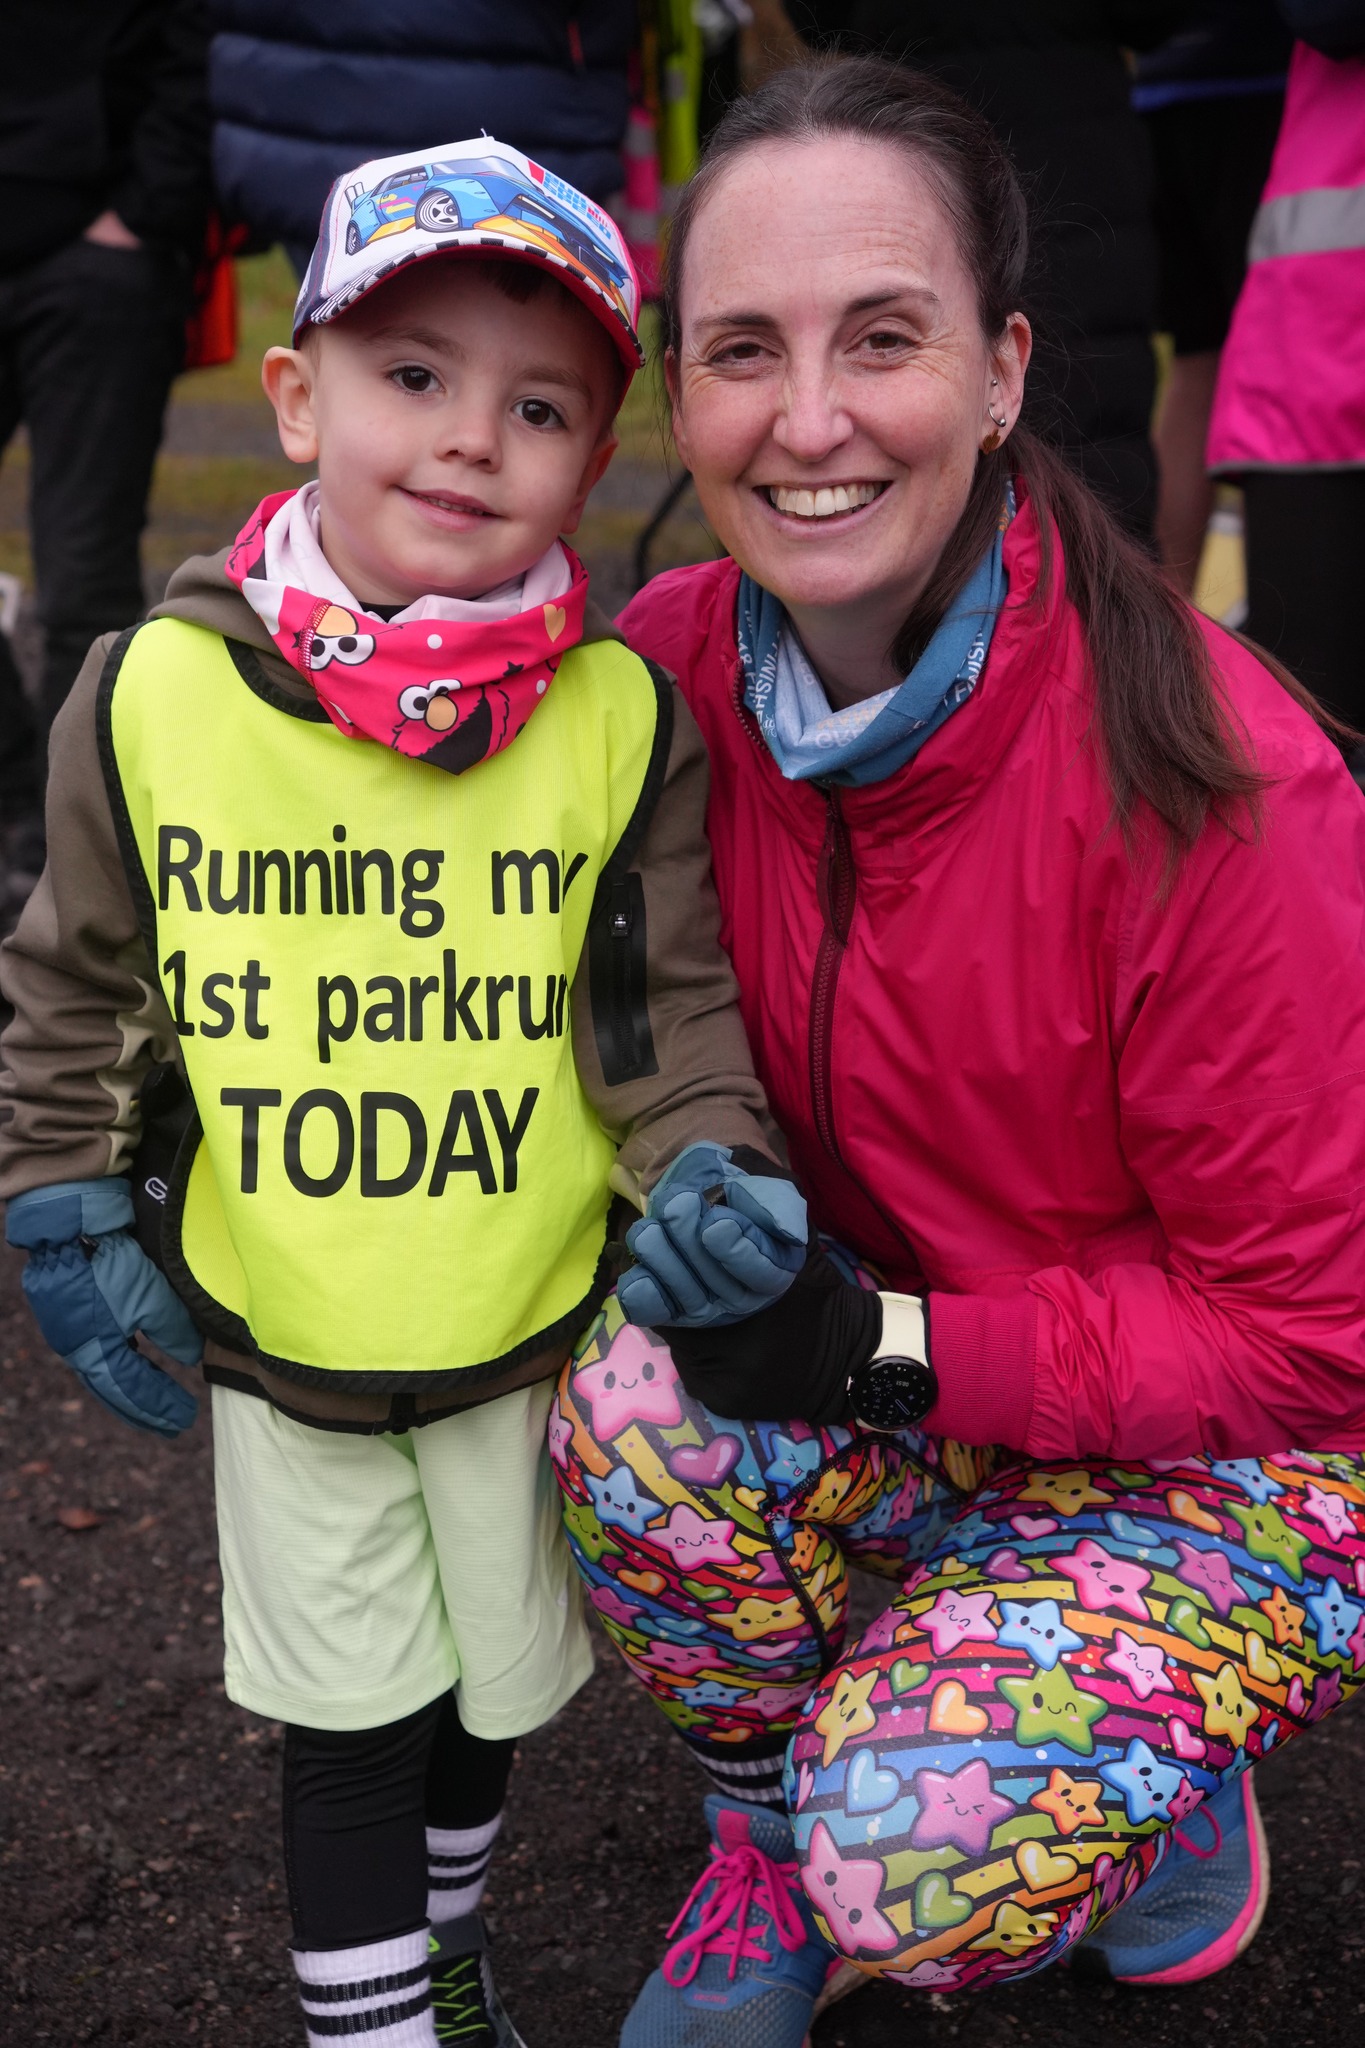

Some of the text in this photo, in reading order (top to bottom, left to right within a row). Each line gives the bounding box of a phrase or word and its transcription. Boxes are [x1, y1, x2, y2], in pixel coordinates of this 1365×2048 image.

[157, 824, 589, 939] Running my
[163, 949, 571, 1064] 1st parkrun
[221, 1087, 540, 1198] TODAY
